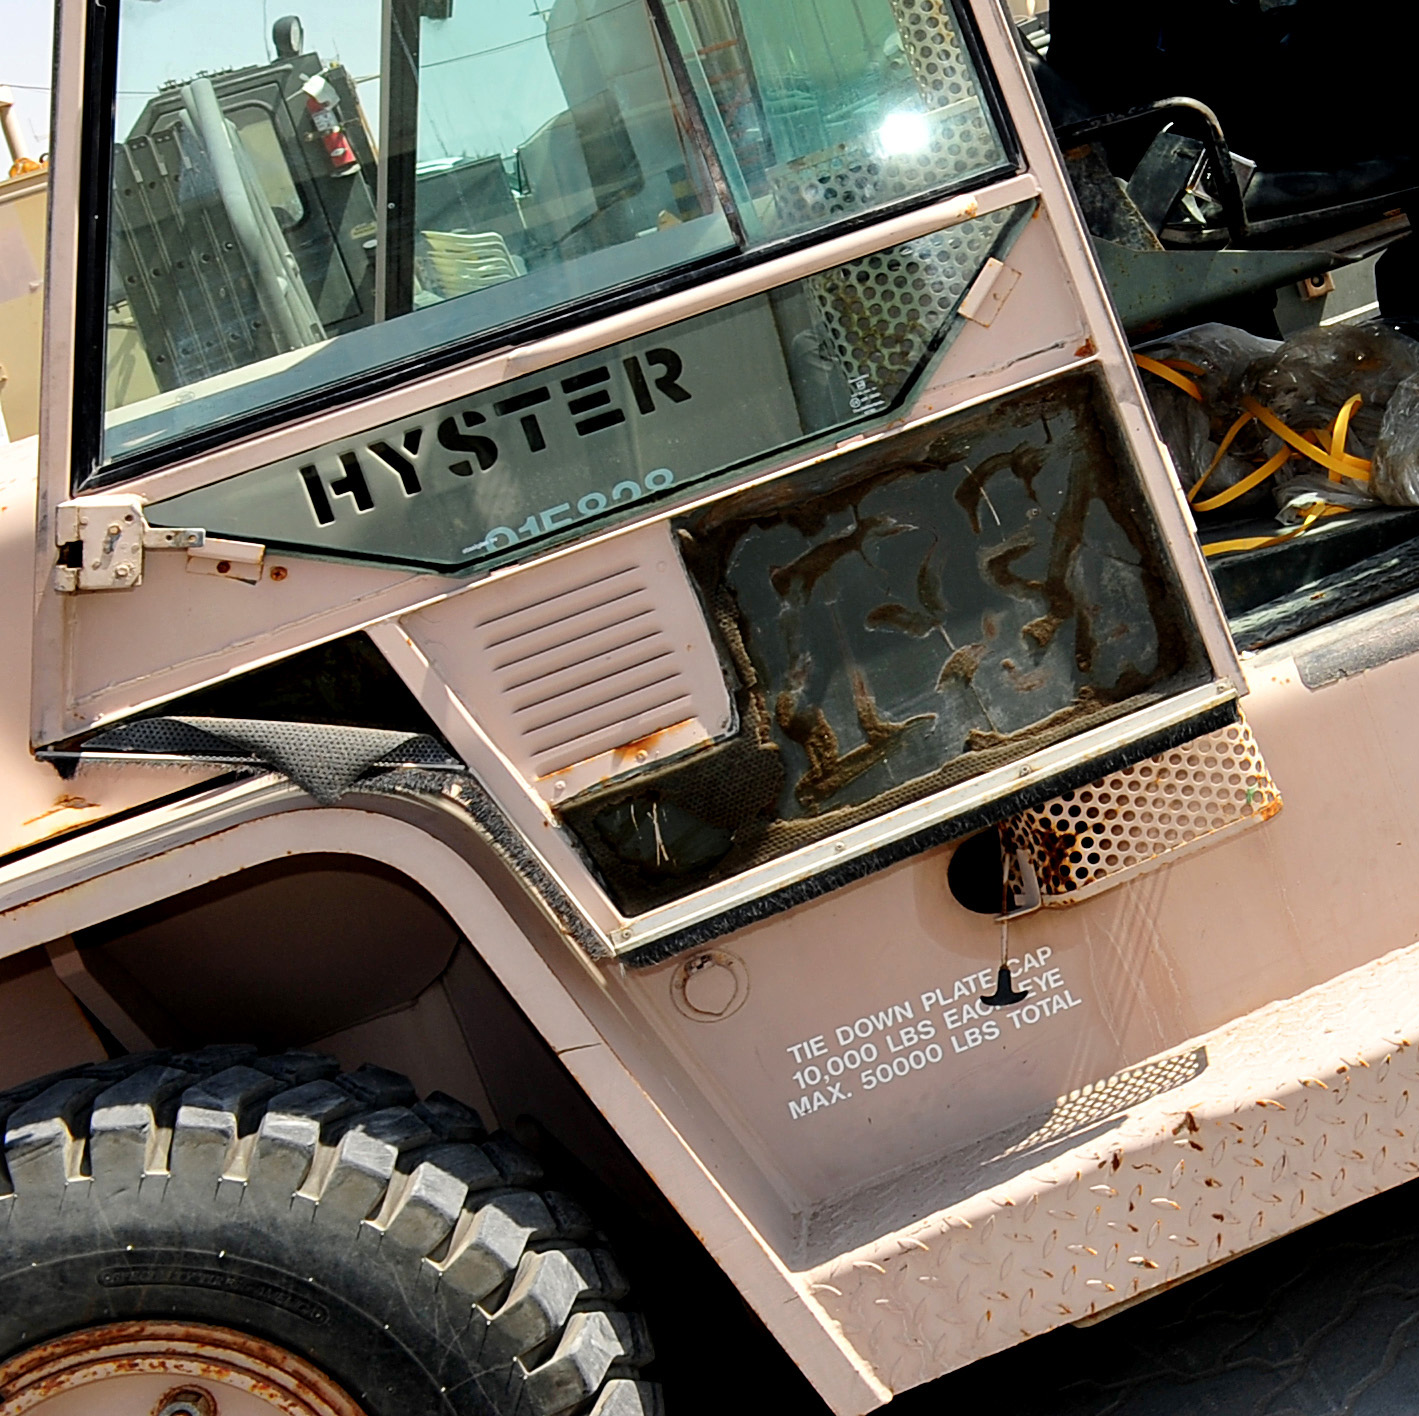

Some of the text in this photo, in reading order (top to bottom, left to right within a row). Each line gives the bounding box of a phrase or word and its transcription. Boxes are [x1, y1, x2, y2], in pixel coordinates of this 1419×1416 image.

[299, 347, 692, 527] HYSTER
[787, 946, 1053, 1064] TIE DOWN PLATE CAP
[788, 989, 1082, 1120] MAX. 50000 LBS TOTAL
[792, 1043, 878, 1090] 10,000
[886, 1019, 936, 1052] LBS
[943, 996, 1004, 1028] EAC
